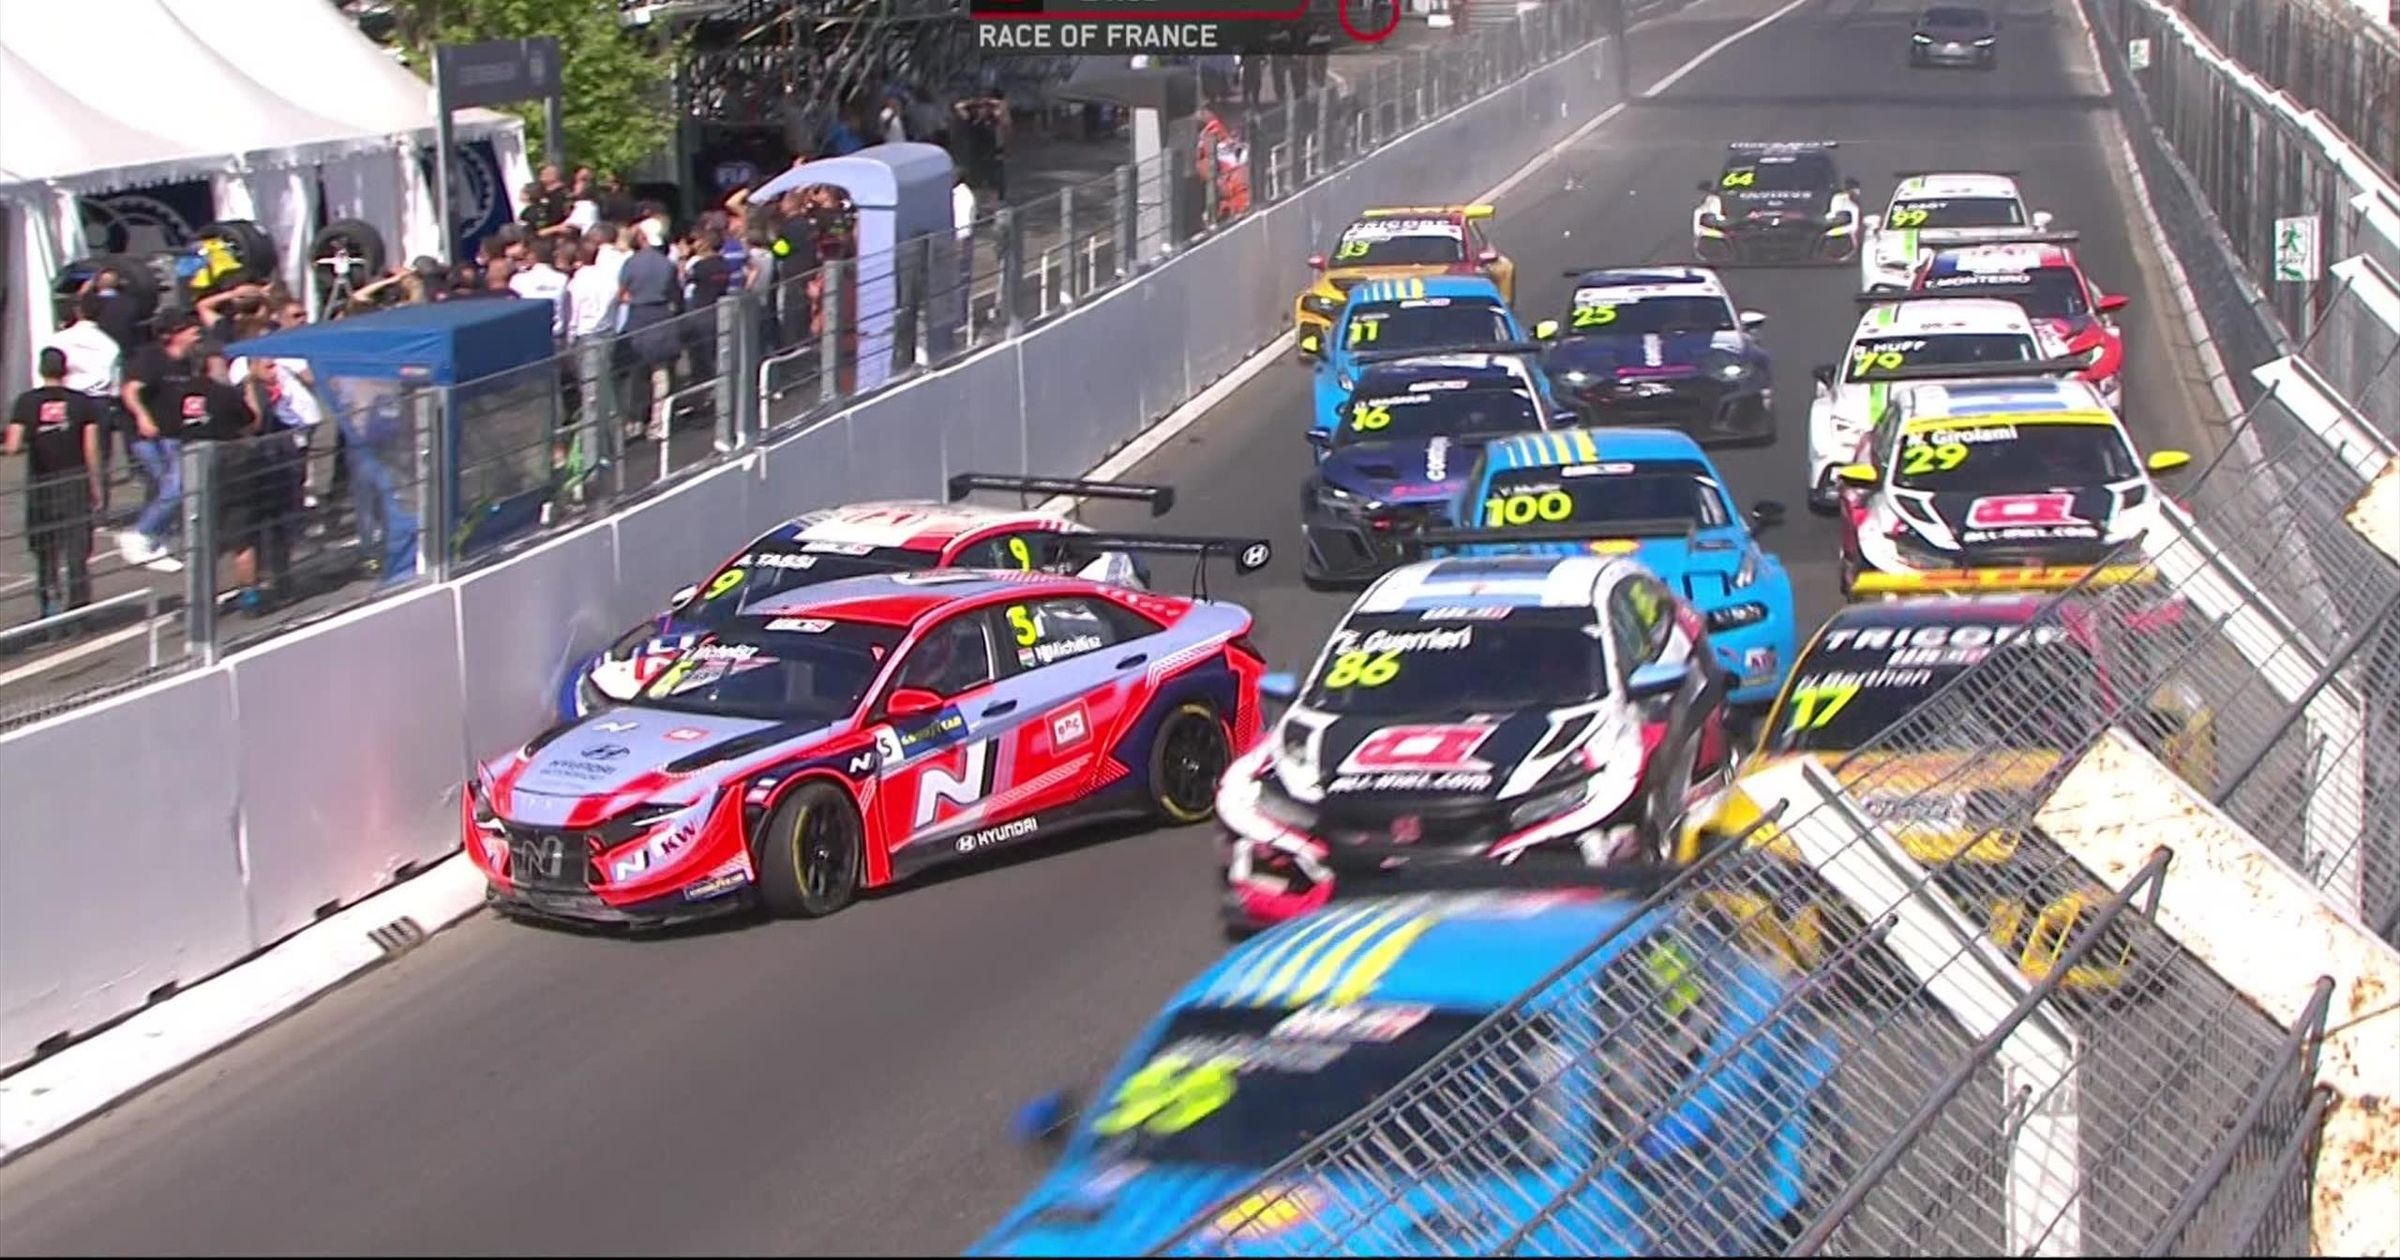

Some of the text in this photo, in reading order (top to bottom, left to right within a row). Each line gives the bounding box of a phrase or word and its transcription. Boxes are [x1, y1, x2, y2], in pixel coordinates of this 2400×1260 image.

[1722, 172, 1755, 187] 64
[1892, 209, 1929, 227] 99
[1349, 319, 1380, 343] 11
[1572, 303, 1618, 327] 25
[1351, 404, 1391, 432] 16
[1903, 442, 1969, 475] 29
[1485, 490, 1573, 528] 100
[1009, 537, 1031, 573] 9
[703, 568, 746, 600] 9
[1006, 604, 1038, 646] 5
[1325, 648, 1402, 689] 86
[1789, 684, 1862, 730] 17
[660, 820, 697, 855] KW
[977, 816, 1039, 846] HYUNDAI
